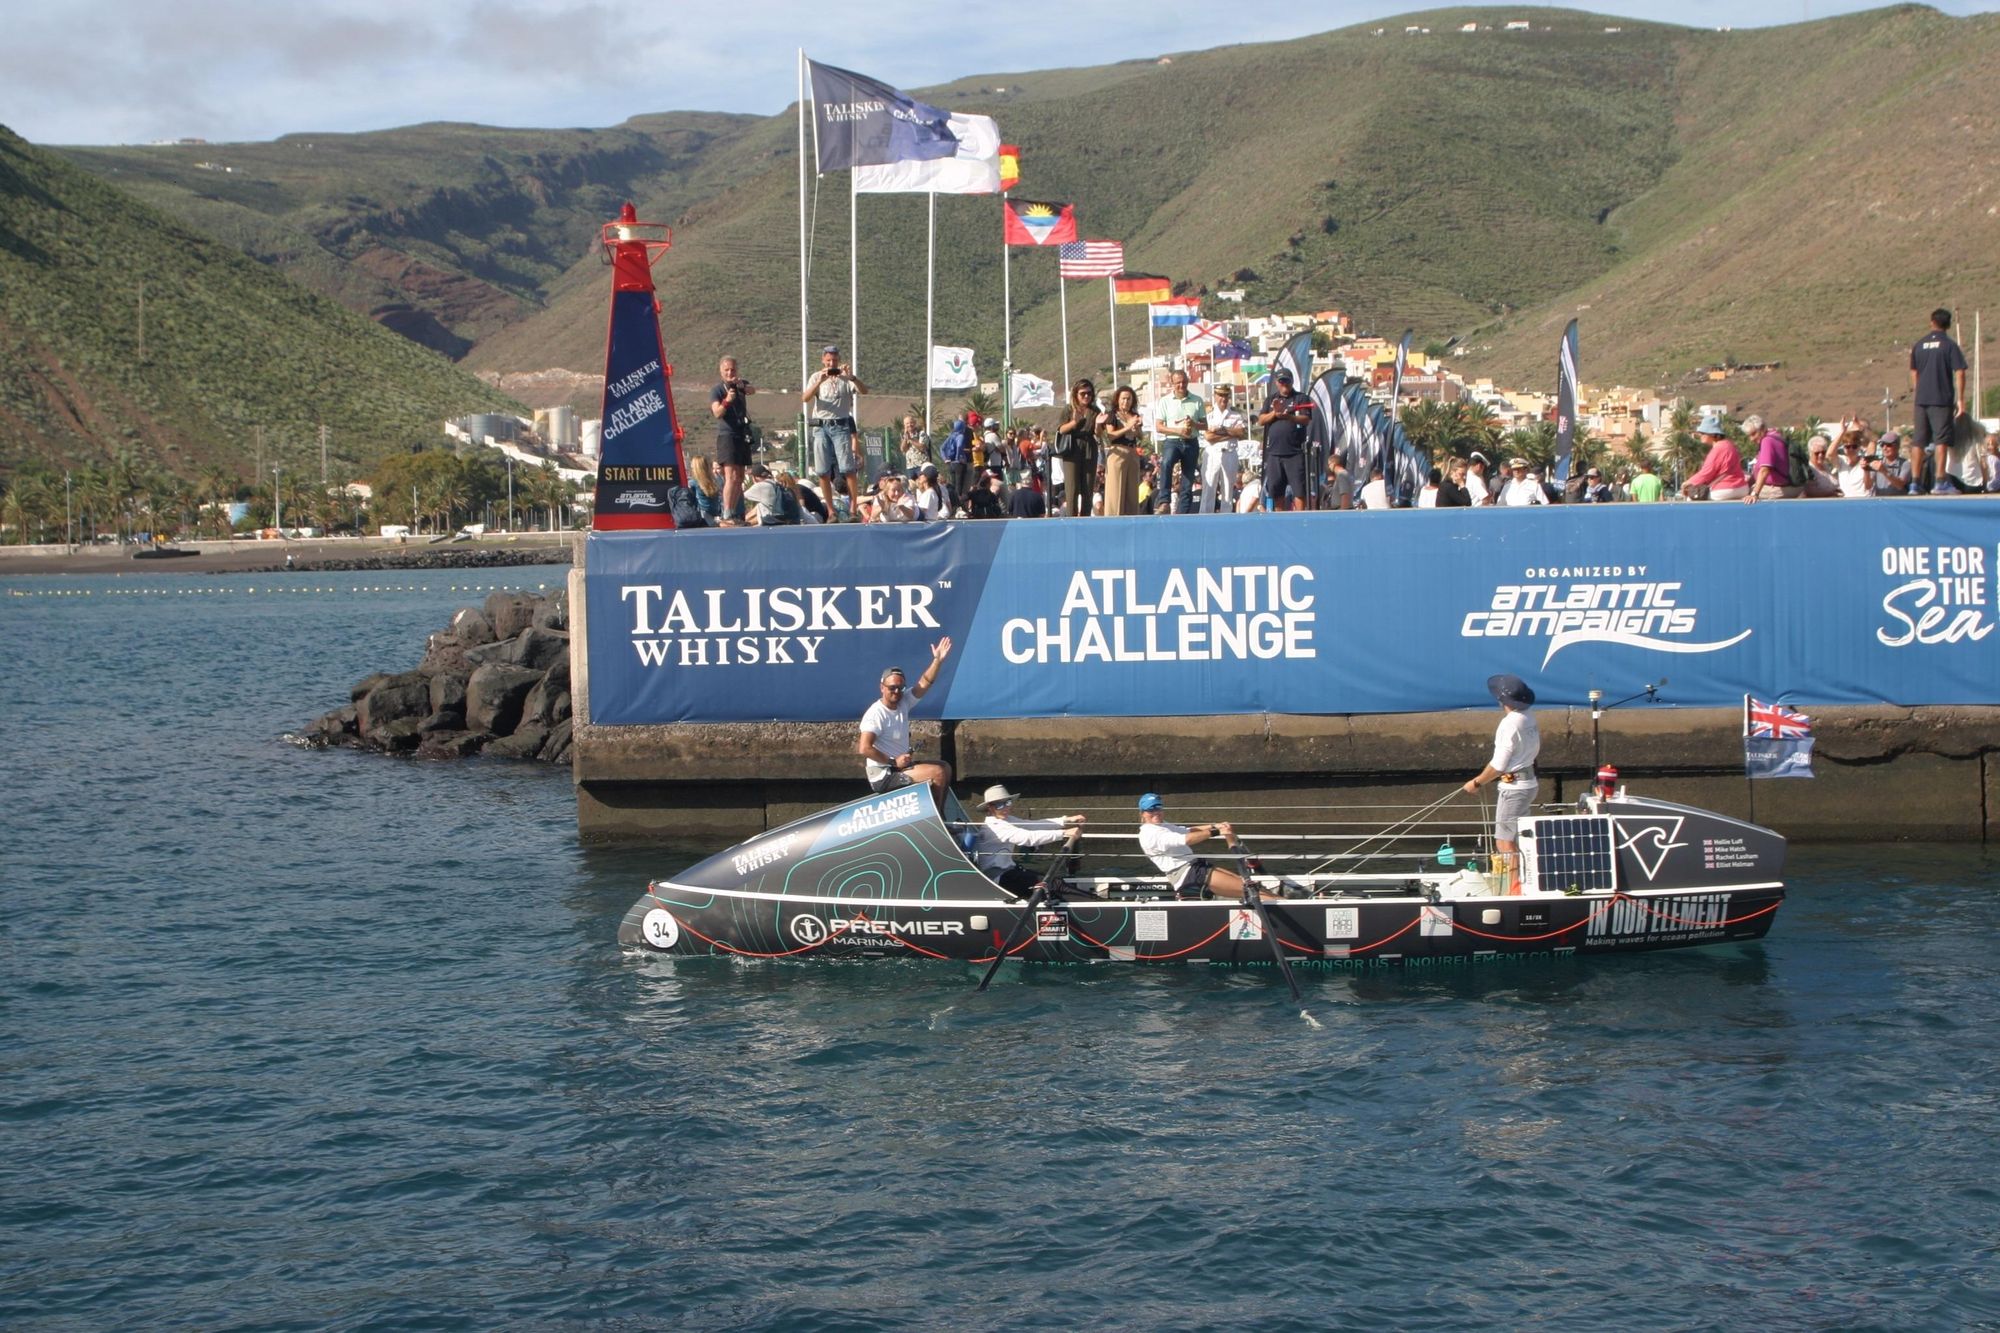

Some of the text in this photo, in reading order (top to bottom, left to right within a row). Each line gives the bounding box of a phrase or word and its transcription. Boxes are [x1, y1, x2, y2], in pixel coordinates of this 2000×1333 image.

[826, 112, 868, 122] WHISKY
[608, 360, 659, 394] TALISKER
[614, 377, 645, 398] WHISKY
[604, 398, 665, 440] CHALLENGE
[611, 389, 659, 424] ATLANTIC
[605, 467, 673, 480] START LINE
[1525, 566, 1647, 578] ORGANIZED BY
[1882, 547, 1985, 575] ONE FOR
[1060, 565, 1315, 616] ATLANTIC
[1938, 577, 1985, 605] THE
[622, 585, 940, 634] TALISKER
[1876, 579, 1995, 647] Sea
[632, 636, 825, 666] WHISKY
[1001, 612, 1316, 664] CHALLENGE
[852, 791, 918, 820] ATLANTIC
[838, 804, 921, 836] CHALLENGE
[736, 847, 789, 875] WHISKY
[829, 919, 966, 935] PREMIER
[1587, 894, 1732, 936] IN OUR ELEMENT
[653, 922, 669, 938] 34
[833, 937, 905, 947] MARINAS
[1585, 938, 1616, 947] Making
[1647, 935, 1660, 943] for
[1688, 931, 1726, 941] pollution
[1369, 958, 1389, 969] US
